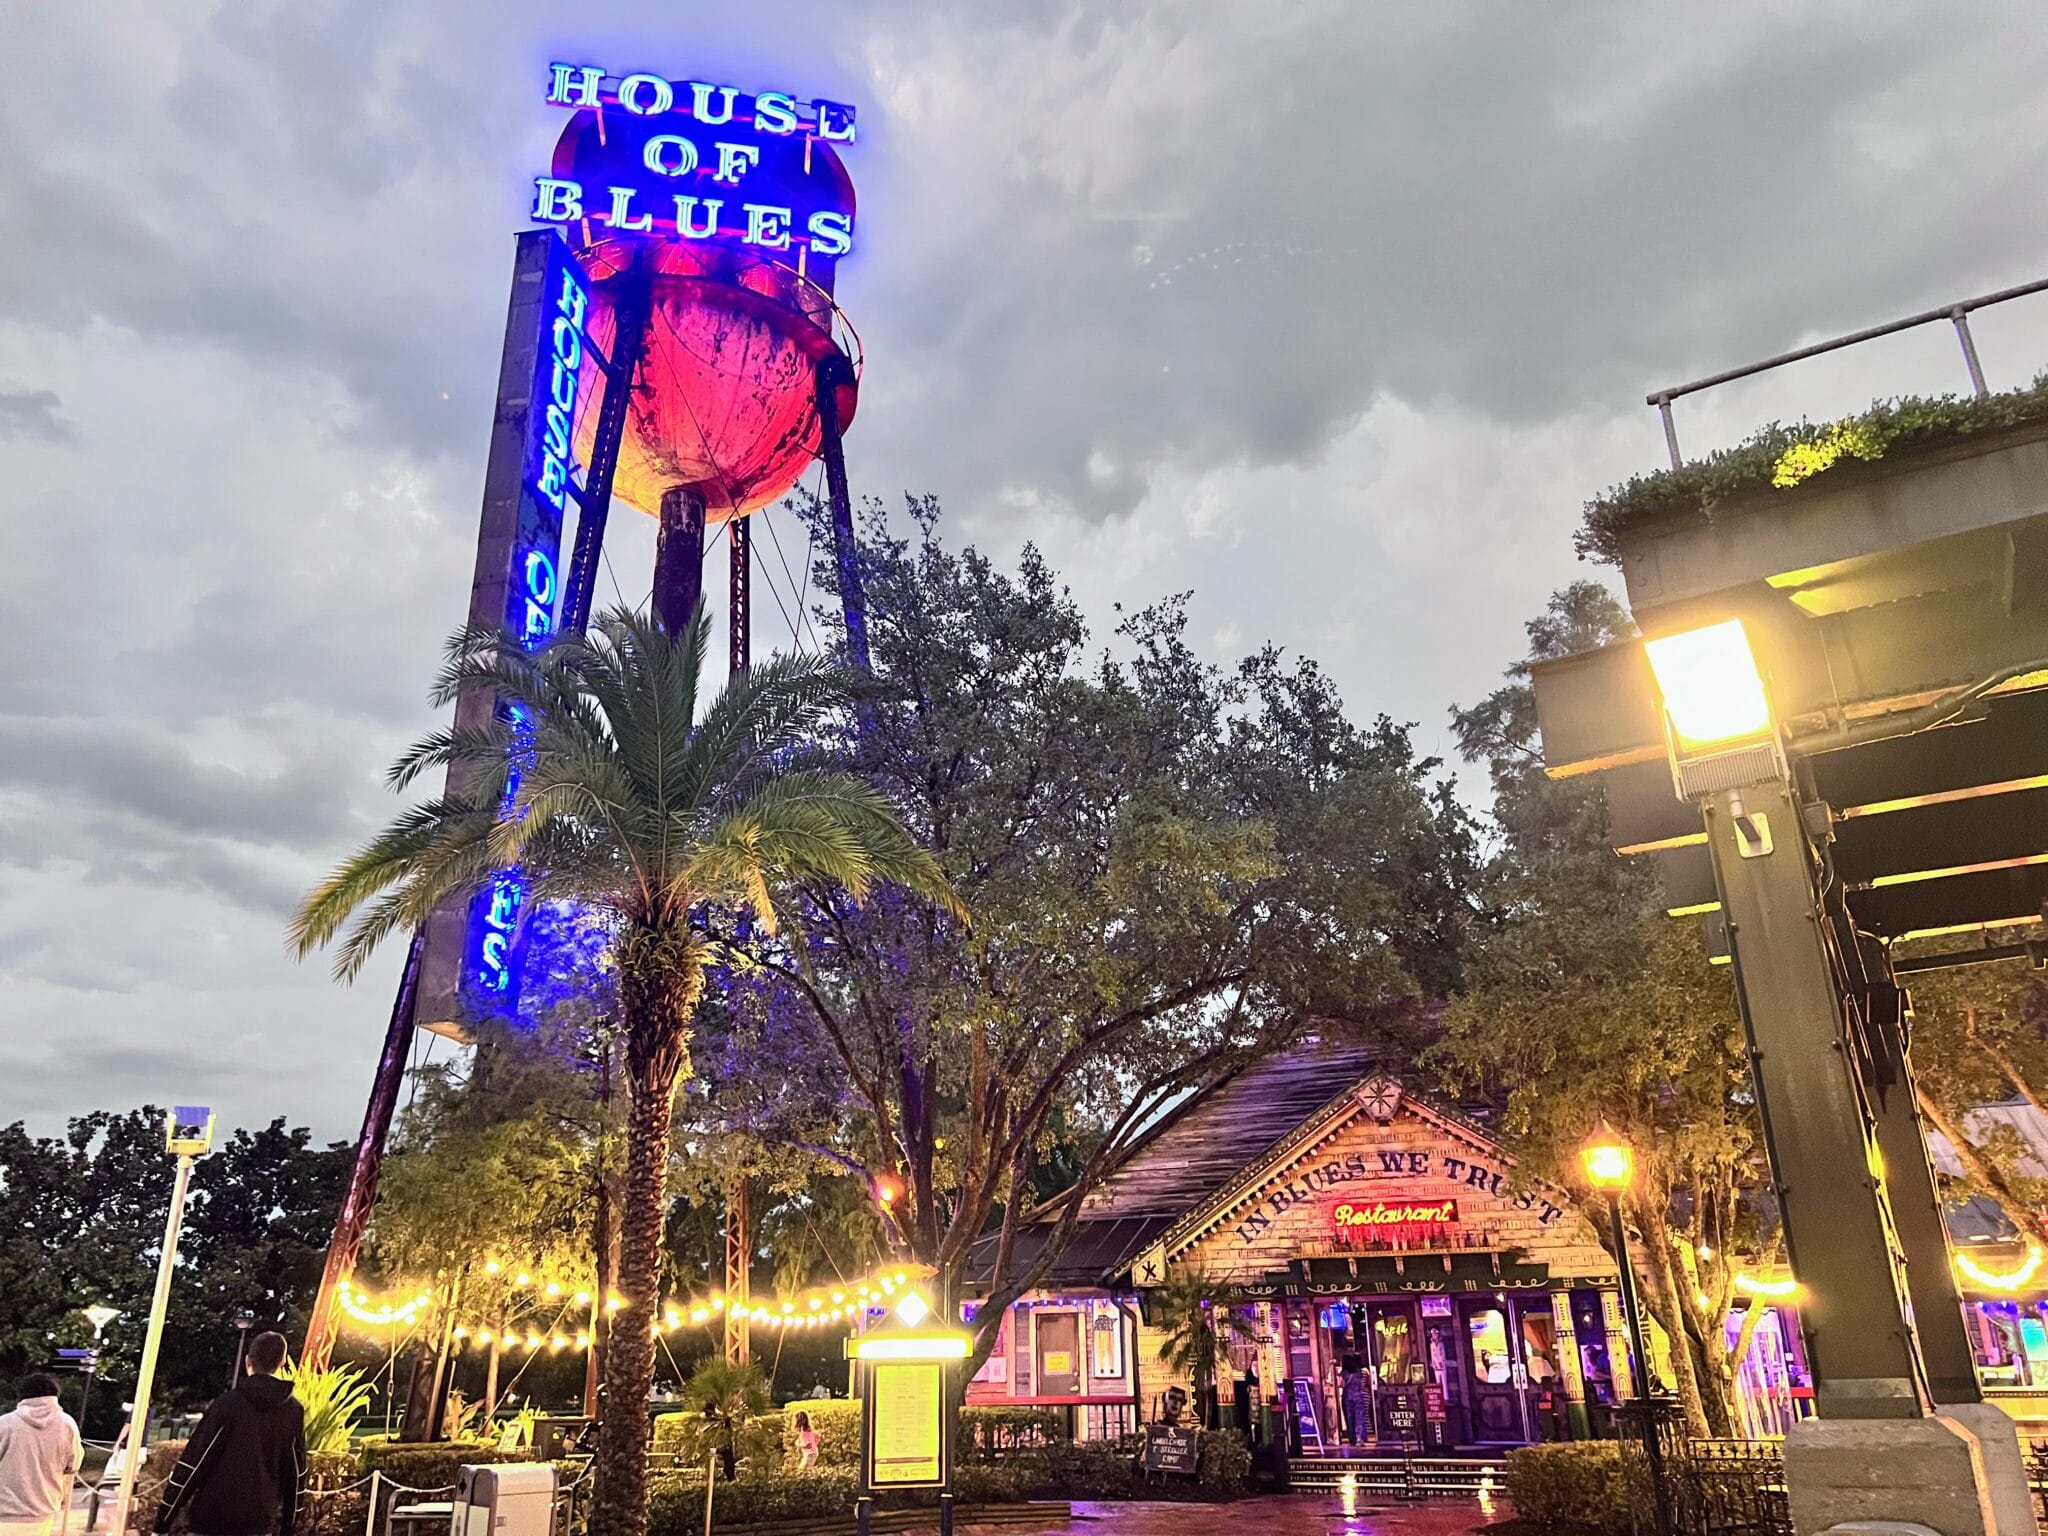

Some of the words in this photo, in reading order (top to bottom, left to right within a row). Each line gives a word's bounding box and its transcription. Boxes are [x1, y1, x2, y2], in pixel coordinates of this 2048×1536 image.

[547, 63, 856, 142] HOUSE
[643, 135, 759, 183] OF
[532, 177, 852, 255] BLUES
[537, 267, 588, 510] HOUSE
[1236, 1208, 1271, 1245] IN
[1268, 1154, 1367, 1215] BLUES
[1377, 1152, 1429, 1174] WE
[1443, 1157, 1563, 1225] TRUST
[1334, 1201, 1454, 1228] Restaurant
[1389, 1411, 1415, 1419] ENTER
[1392, 1419, 1413, 1427] HERE
